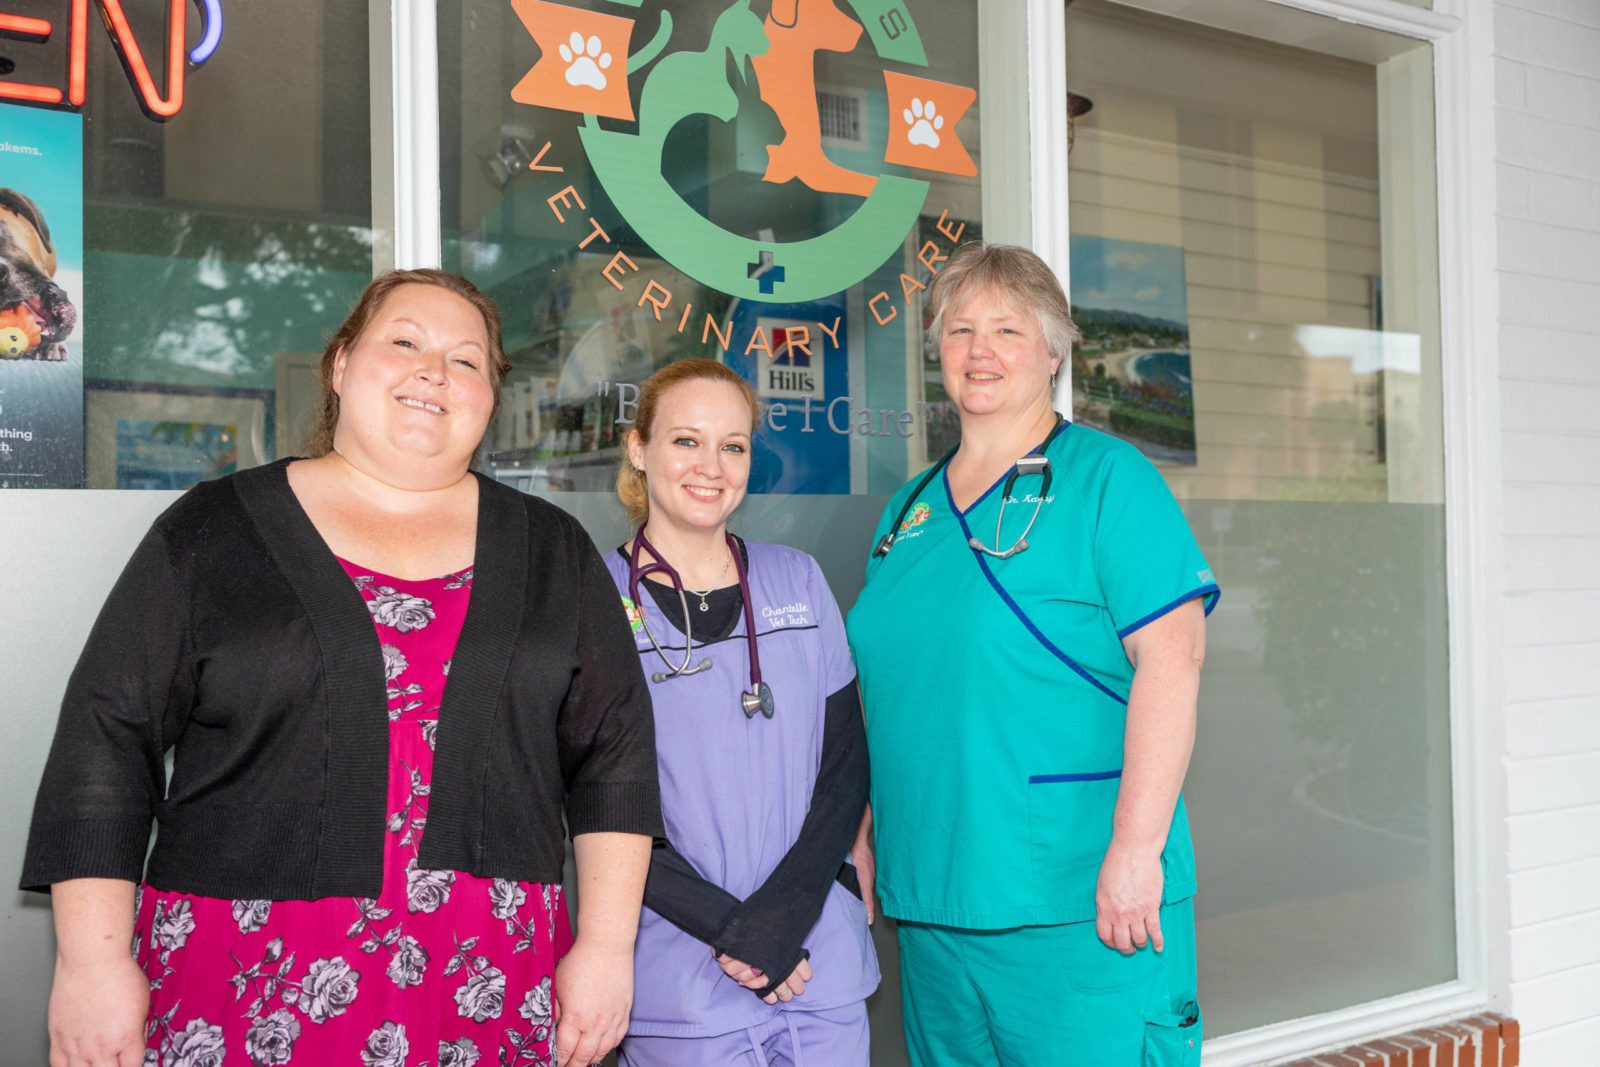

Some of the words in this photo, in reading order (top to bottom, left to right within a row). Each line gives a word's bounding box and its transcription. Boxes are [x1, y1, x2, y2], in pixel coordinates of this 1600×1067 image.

[529, 140, 841, 358] VETERINARY
[868, 208, 966, 326] CARE
[769, 370, 815, 392] Hill's
[800, 394, 815, 433] I
[762, 602, 808, 618] Chantelle
[769, 616, 787, 628] Vet
[787, 613, 809, 626] Tech
